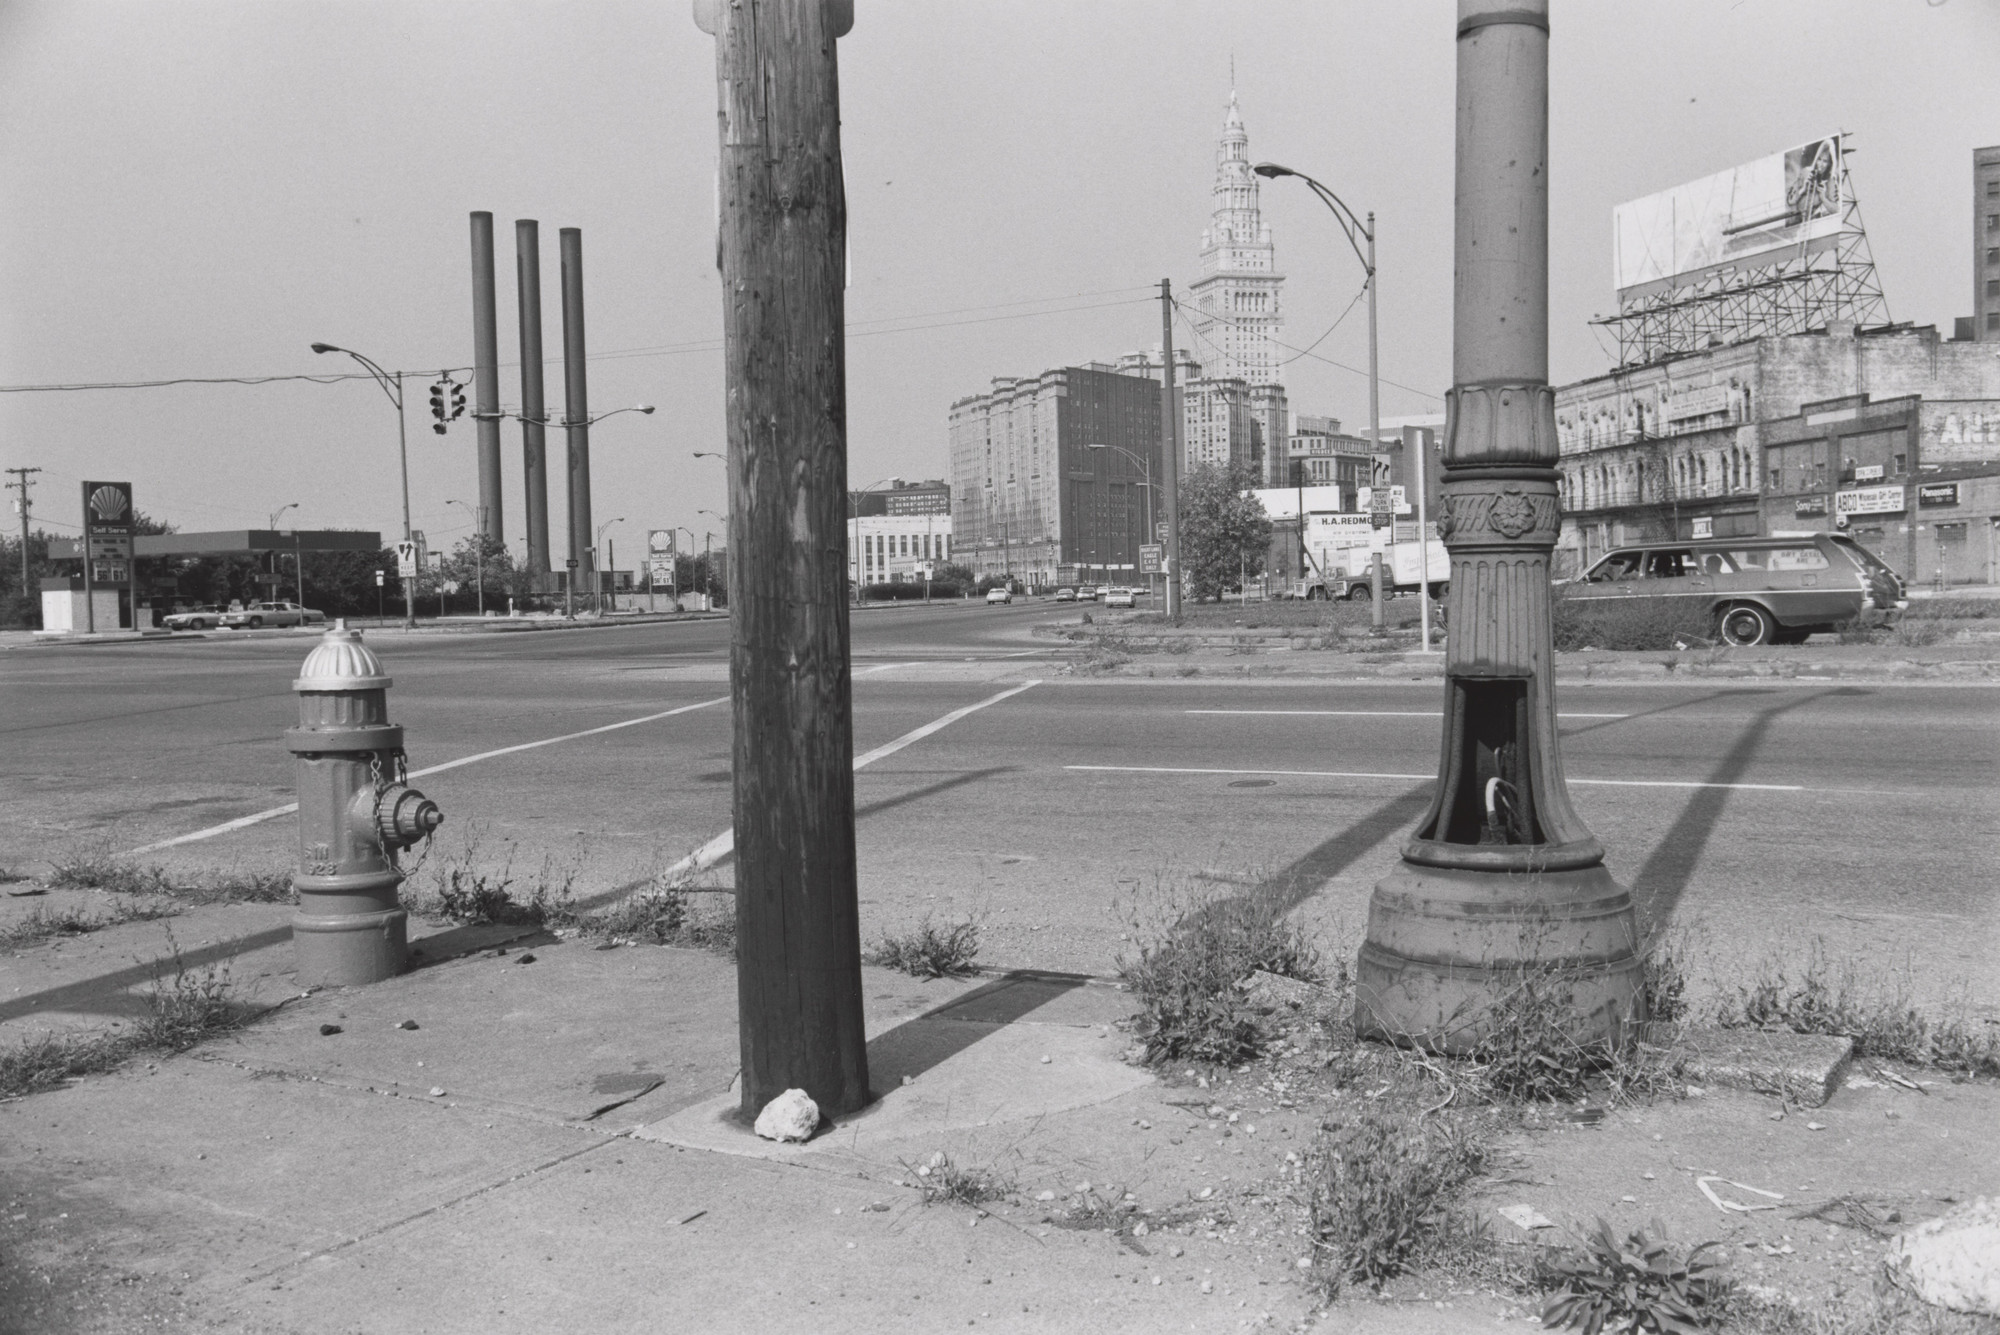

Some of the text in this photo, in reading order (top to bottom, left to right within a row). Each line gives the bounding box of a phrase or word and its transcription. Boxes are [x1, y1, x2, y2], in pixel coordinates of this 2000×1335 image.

[1920, 485, 1954, 498] Panasonic
[1795, 500, 1811, 513] Sony
[1837, 493, 1857, 513] ABCO
[92, 526, 128, 534] Self Serve
